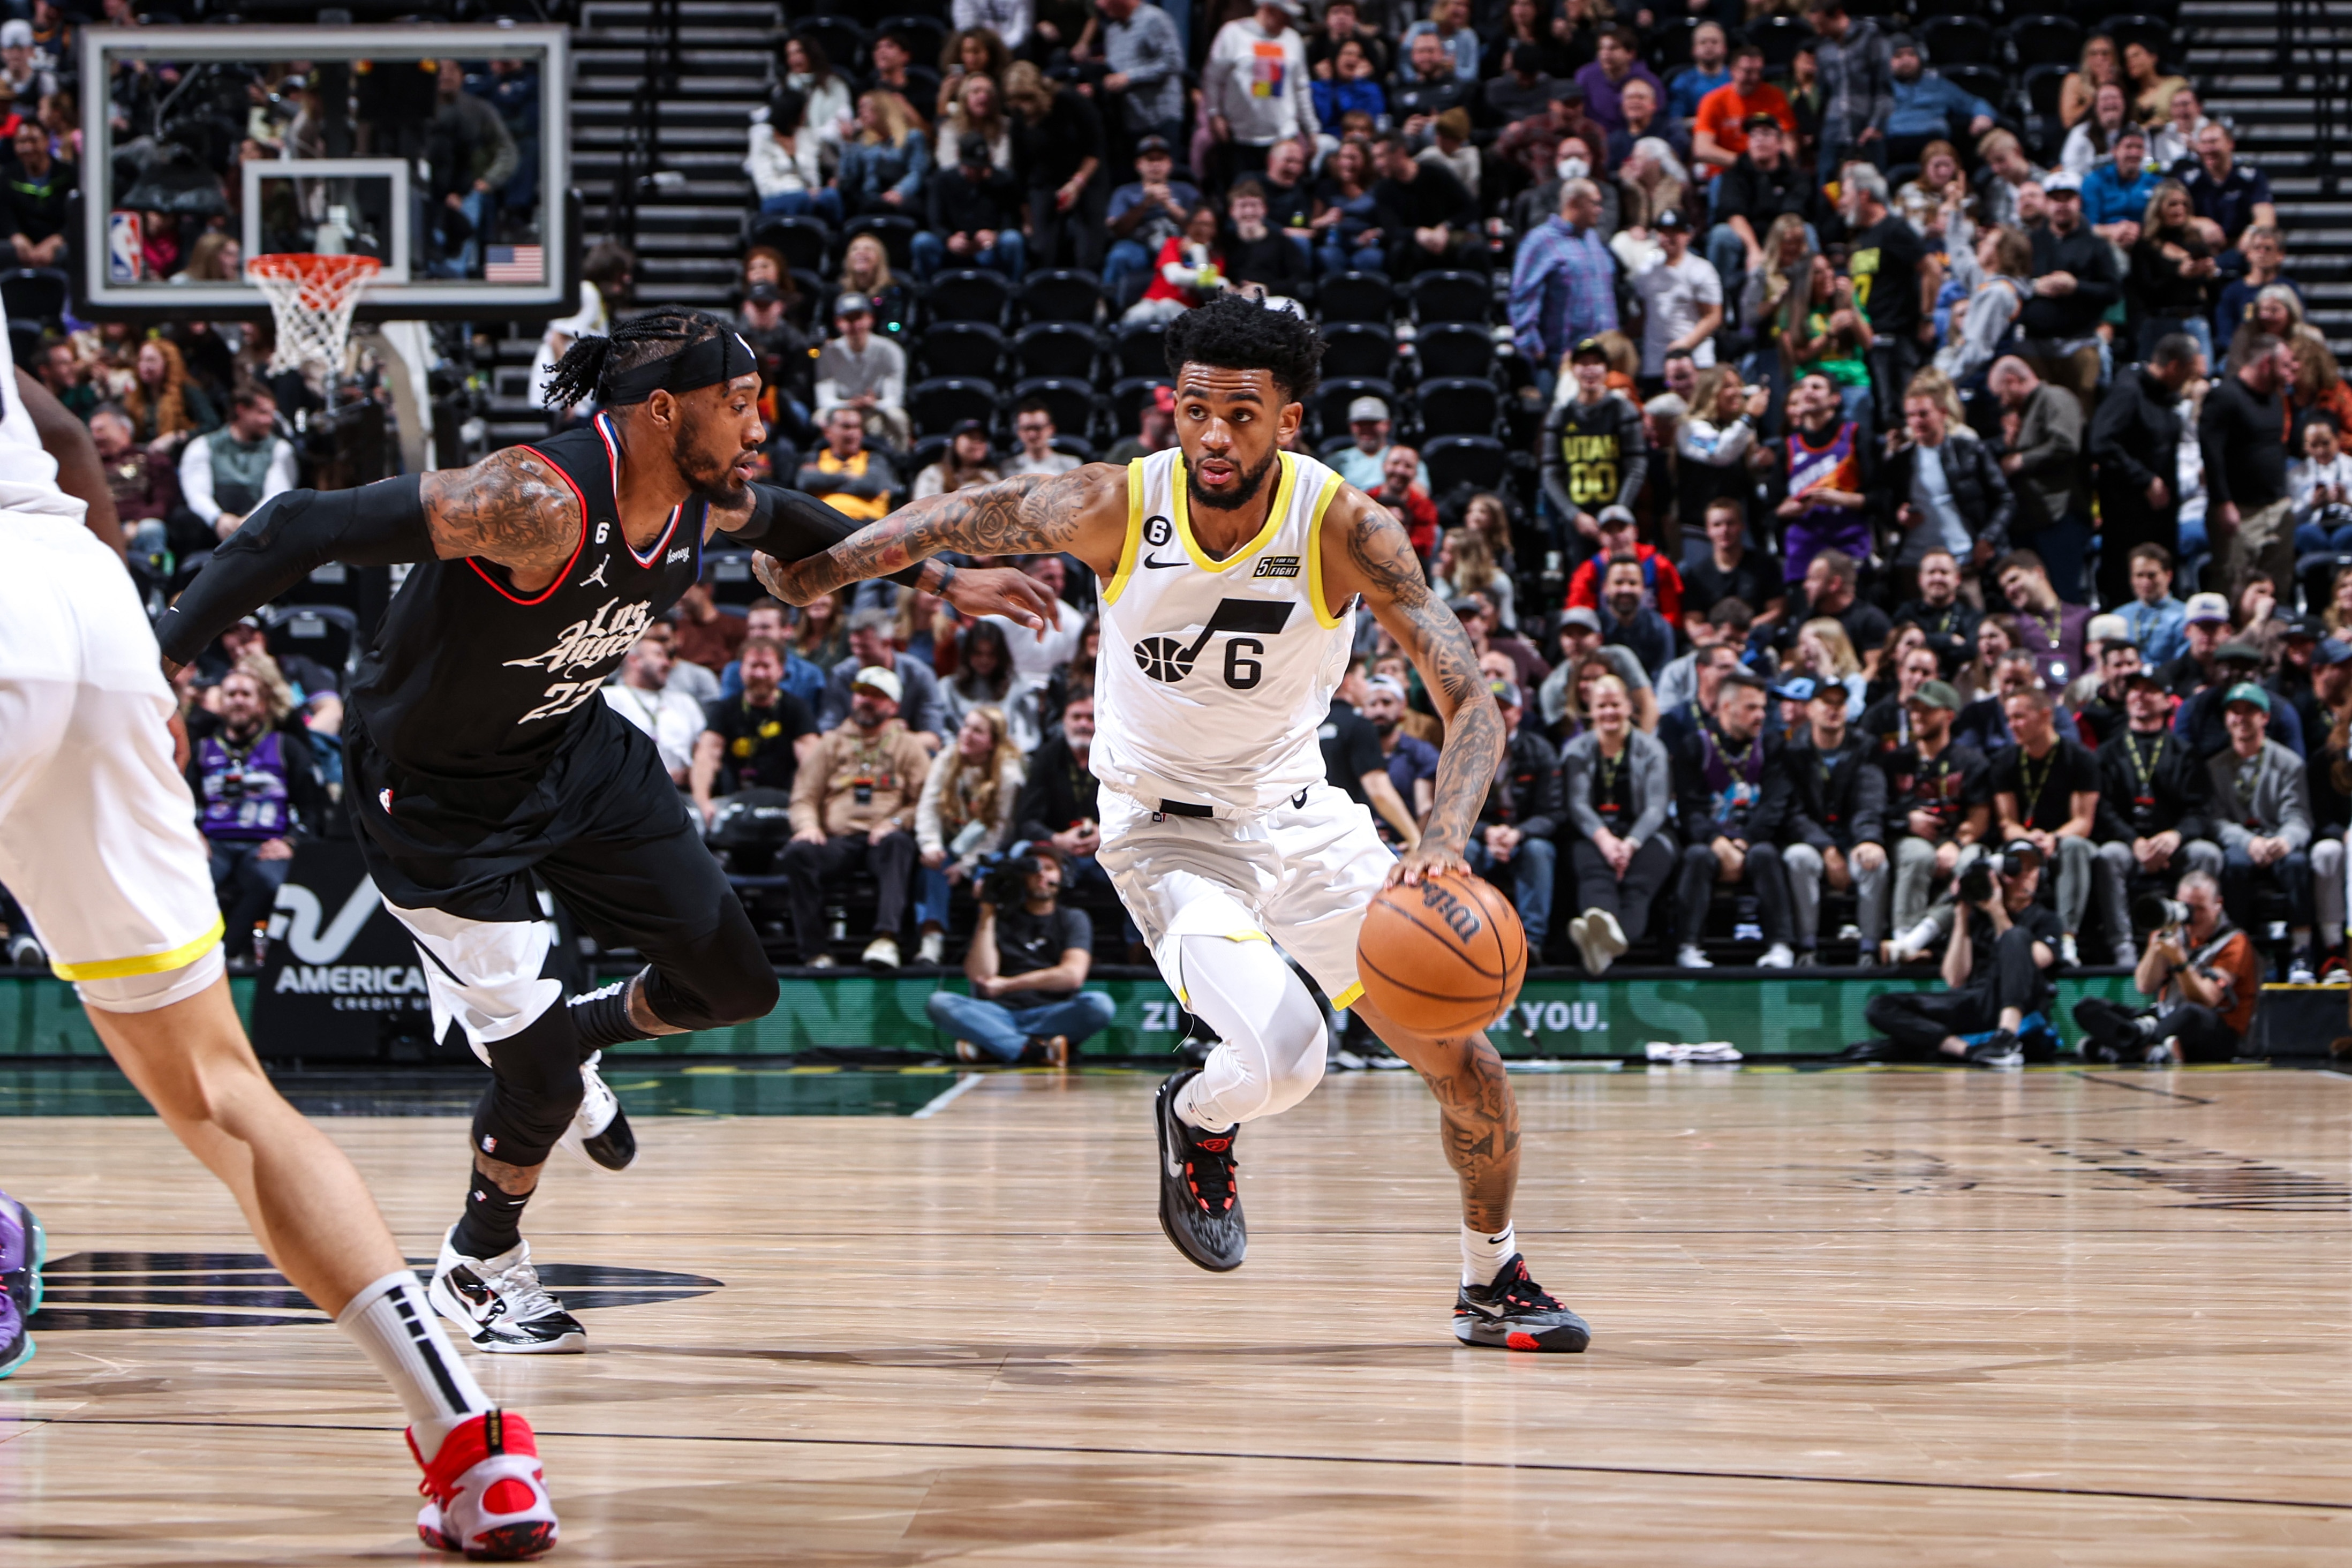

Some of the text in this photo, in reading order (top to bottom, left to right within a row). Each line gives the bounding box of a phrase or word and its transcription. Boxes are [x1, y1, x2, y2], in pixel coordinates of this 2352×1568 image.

[1562, 434, 1619, 463] UTAH
[595, 522, 610, 545] 6
[1149, 519, 1167, 543] 6
[666, 546, 690, 565] honey
[1255, 558, 1272, 576] 5
[1269, 567, 1299, 576] FIGHT
[581, 596, 652, 639] Los
[502, 616, 655, 679] Angel
[1224, 637, 1264, 690] 6
[274, 966, 428, 994] AMERICA
[331, 997, 404, 1011] CREDIT
[1520, 999, 1609, 1032] YOU.
